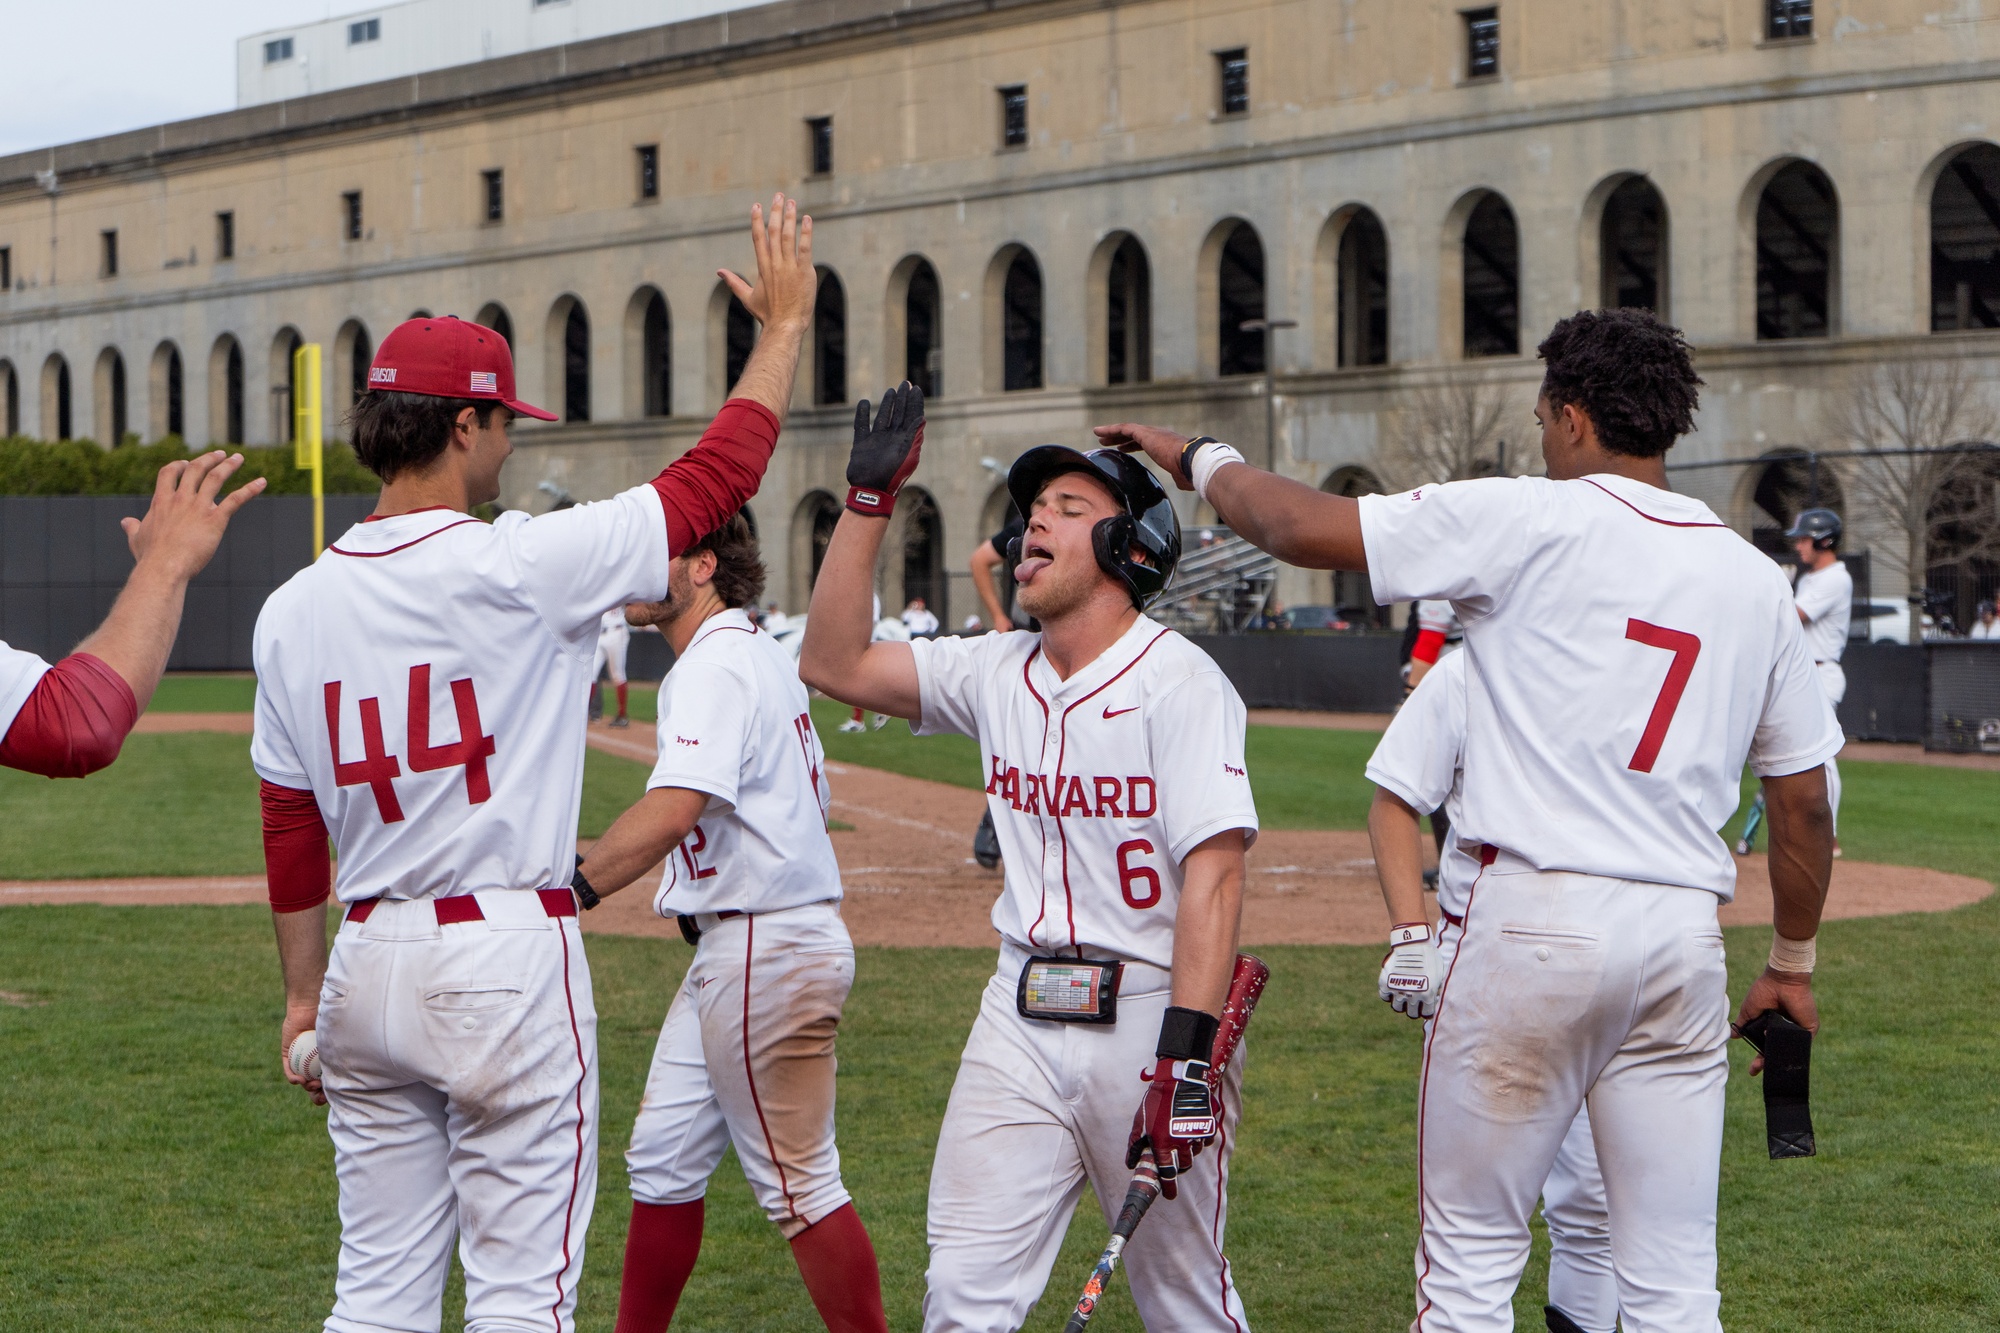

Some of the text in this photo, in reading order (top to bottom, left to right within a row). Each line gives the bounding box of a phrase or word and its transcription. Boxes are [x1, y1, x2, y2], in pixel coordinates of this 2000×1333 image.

[324, 663, 496, 824] 44
[1625, 618, 1702, 773] 7
[986, 754, 1157, 818] HARVARD
[1116, 838, 1161, 909] 6
